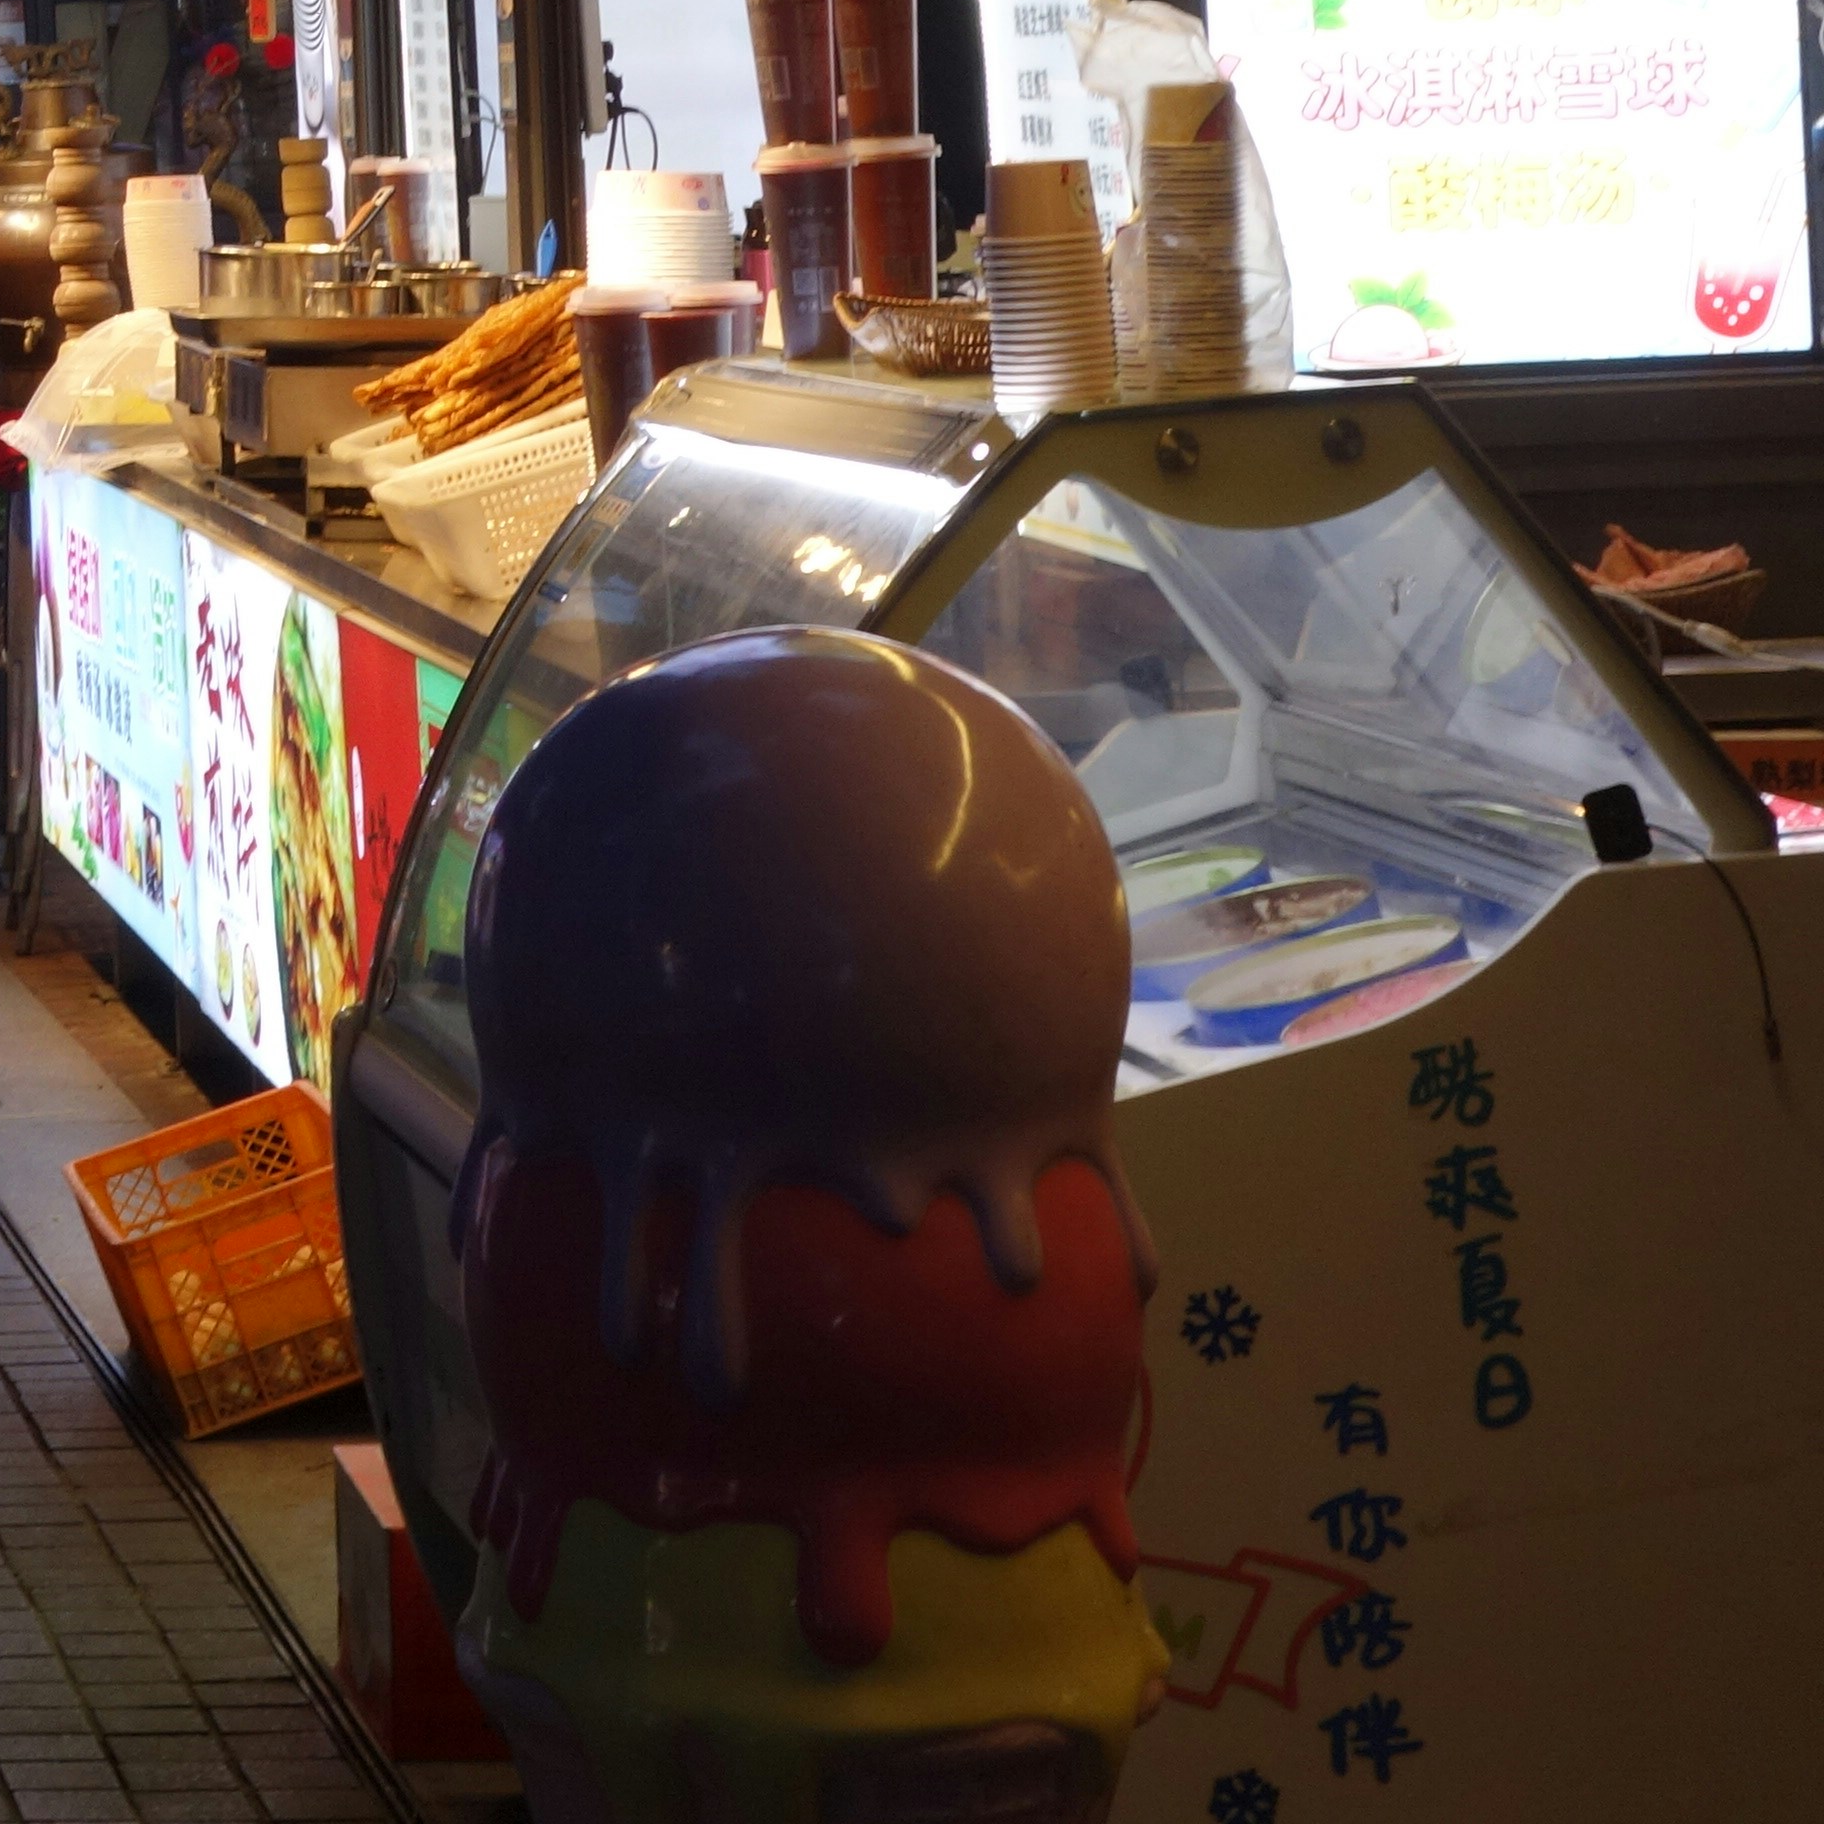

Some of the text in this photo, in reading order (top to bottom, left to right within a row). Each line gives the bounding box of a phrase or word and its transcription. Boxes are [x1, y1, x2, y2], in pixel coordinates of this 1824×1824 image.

[1300, 37, 1710, 132] 冰淇淋雪球
[1388, 149, 1634, 232] 酸梅汤
[1407, 1036, 1534, 1431] 酷爽夏日
[1310, 1382, 1425, 1783] 有你陪伴
